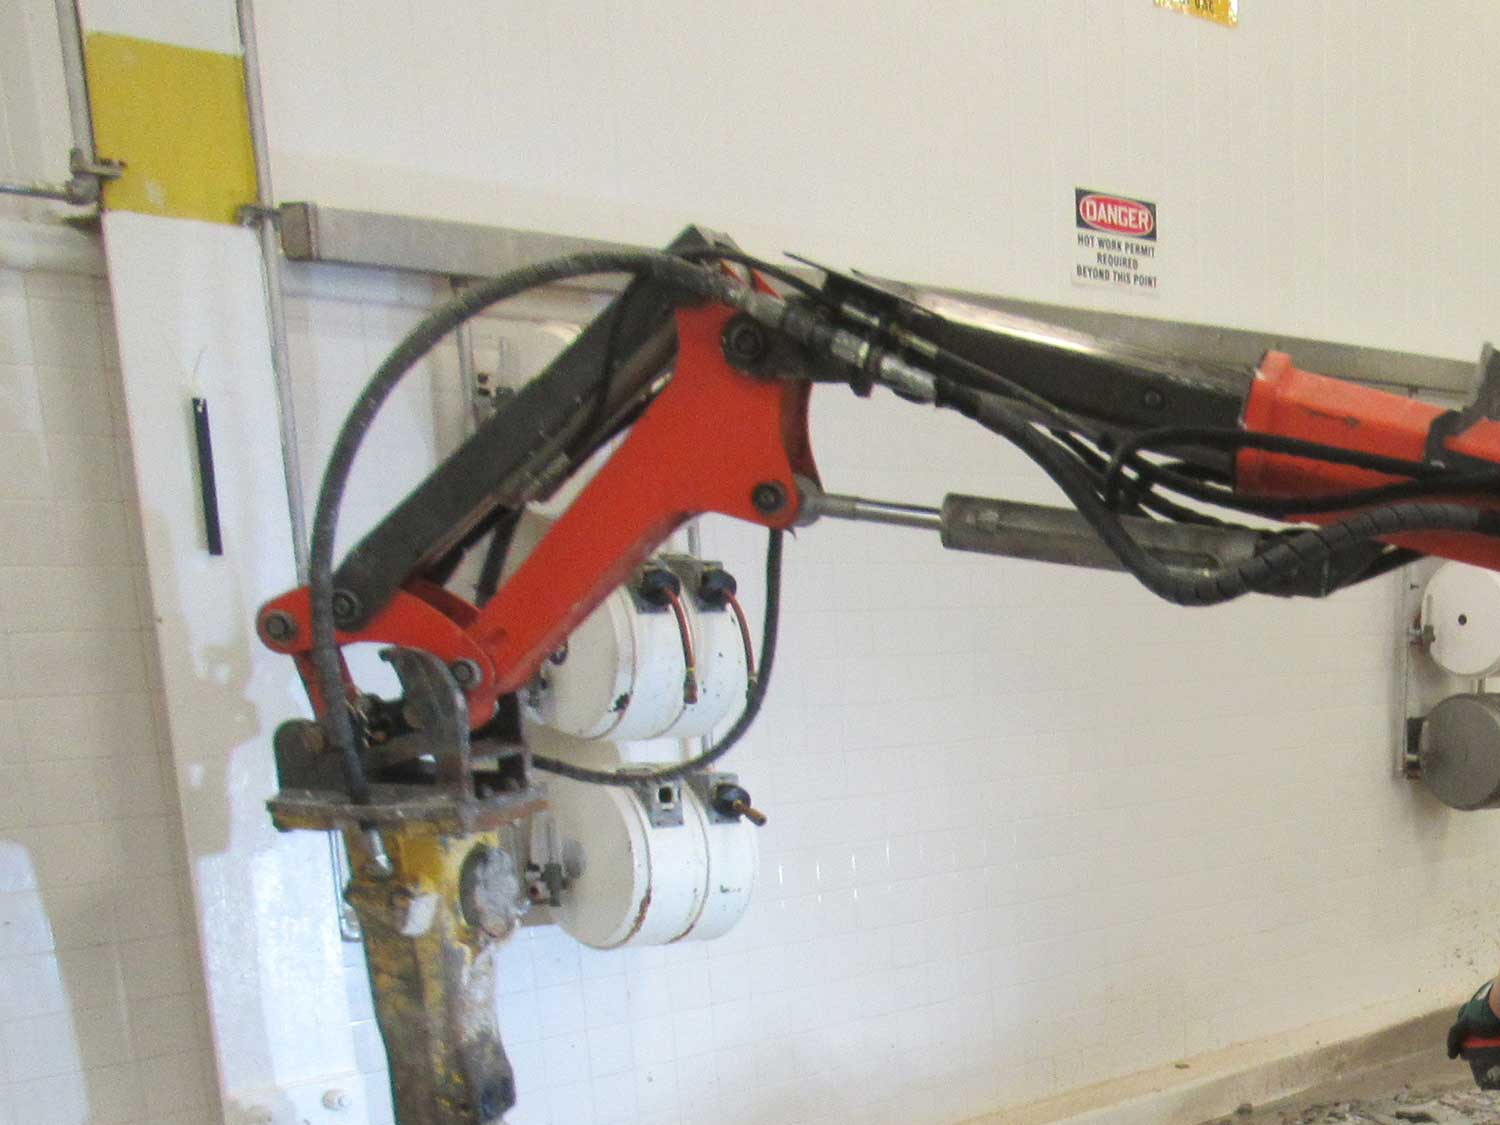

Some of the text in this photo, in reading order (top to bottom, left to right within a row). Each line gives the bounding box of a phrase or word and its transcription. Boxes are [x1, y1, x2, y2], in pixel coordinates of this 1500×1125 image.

[1085, 200, 1149, 231] DANGER
[1077, 233, 1155, 258] HOT WORK PERMIT
[1096, 252, 1138, 271] REQUIRED
[1076, 264, 1157, 288] BEYOND THIS POINT
